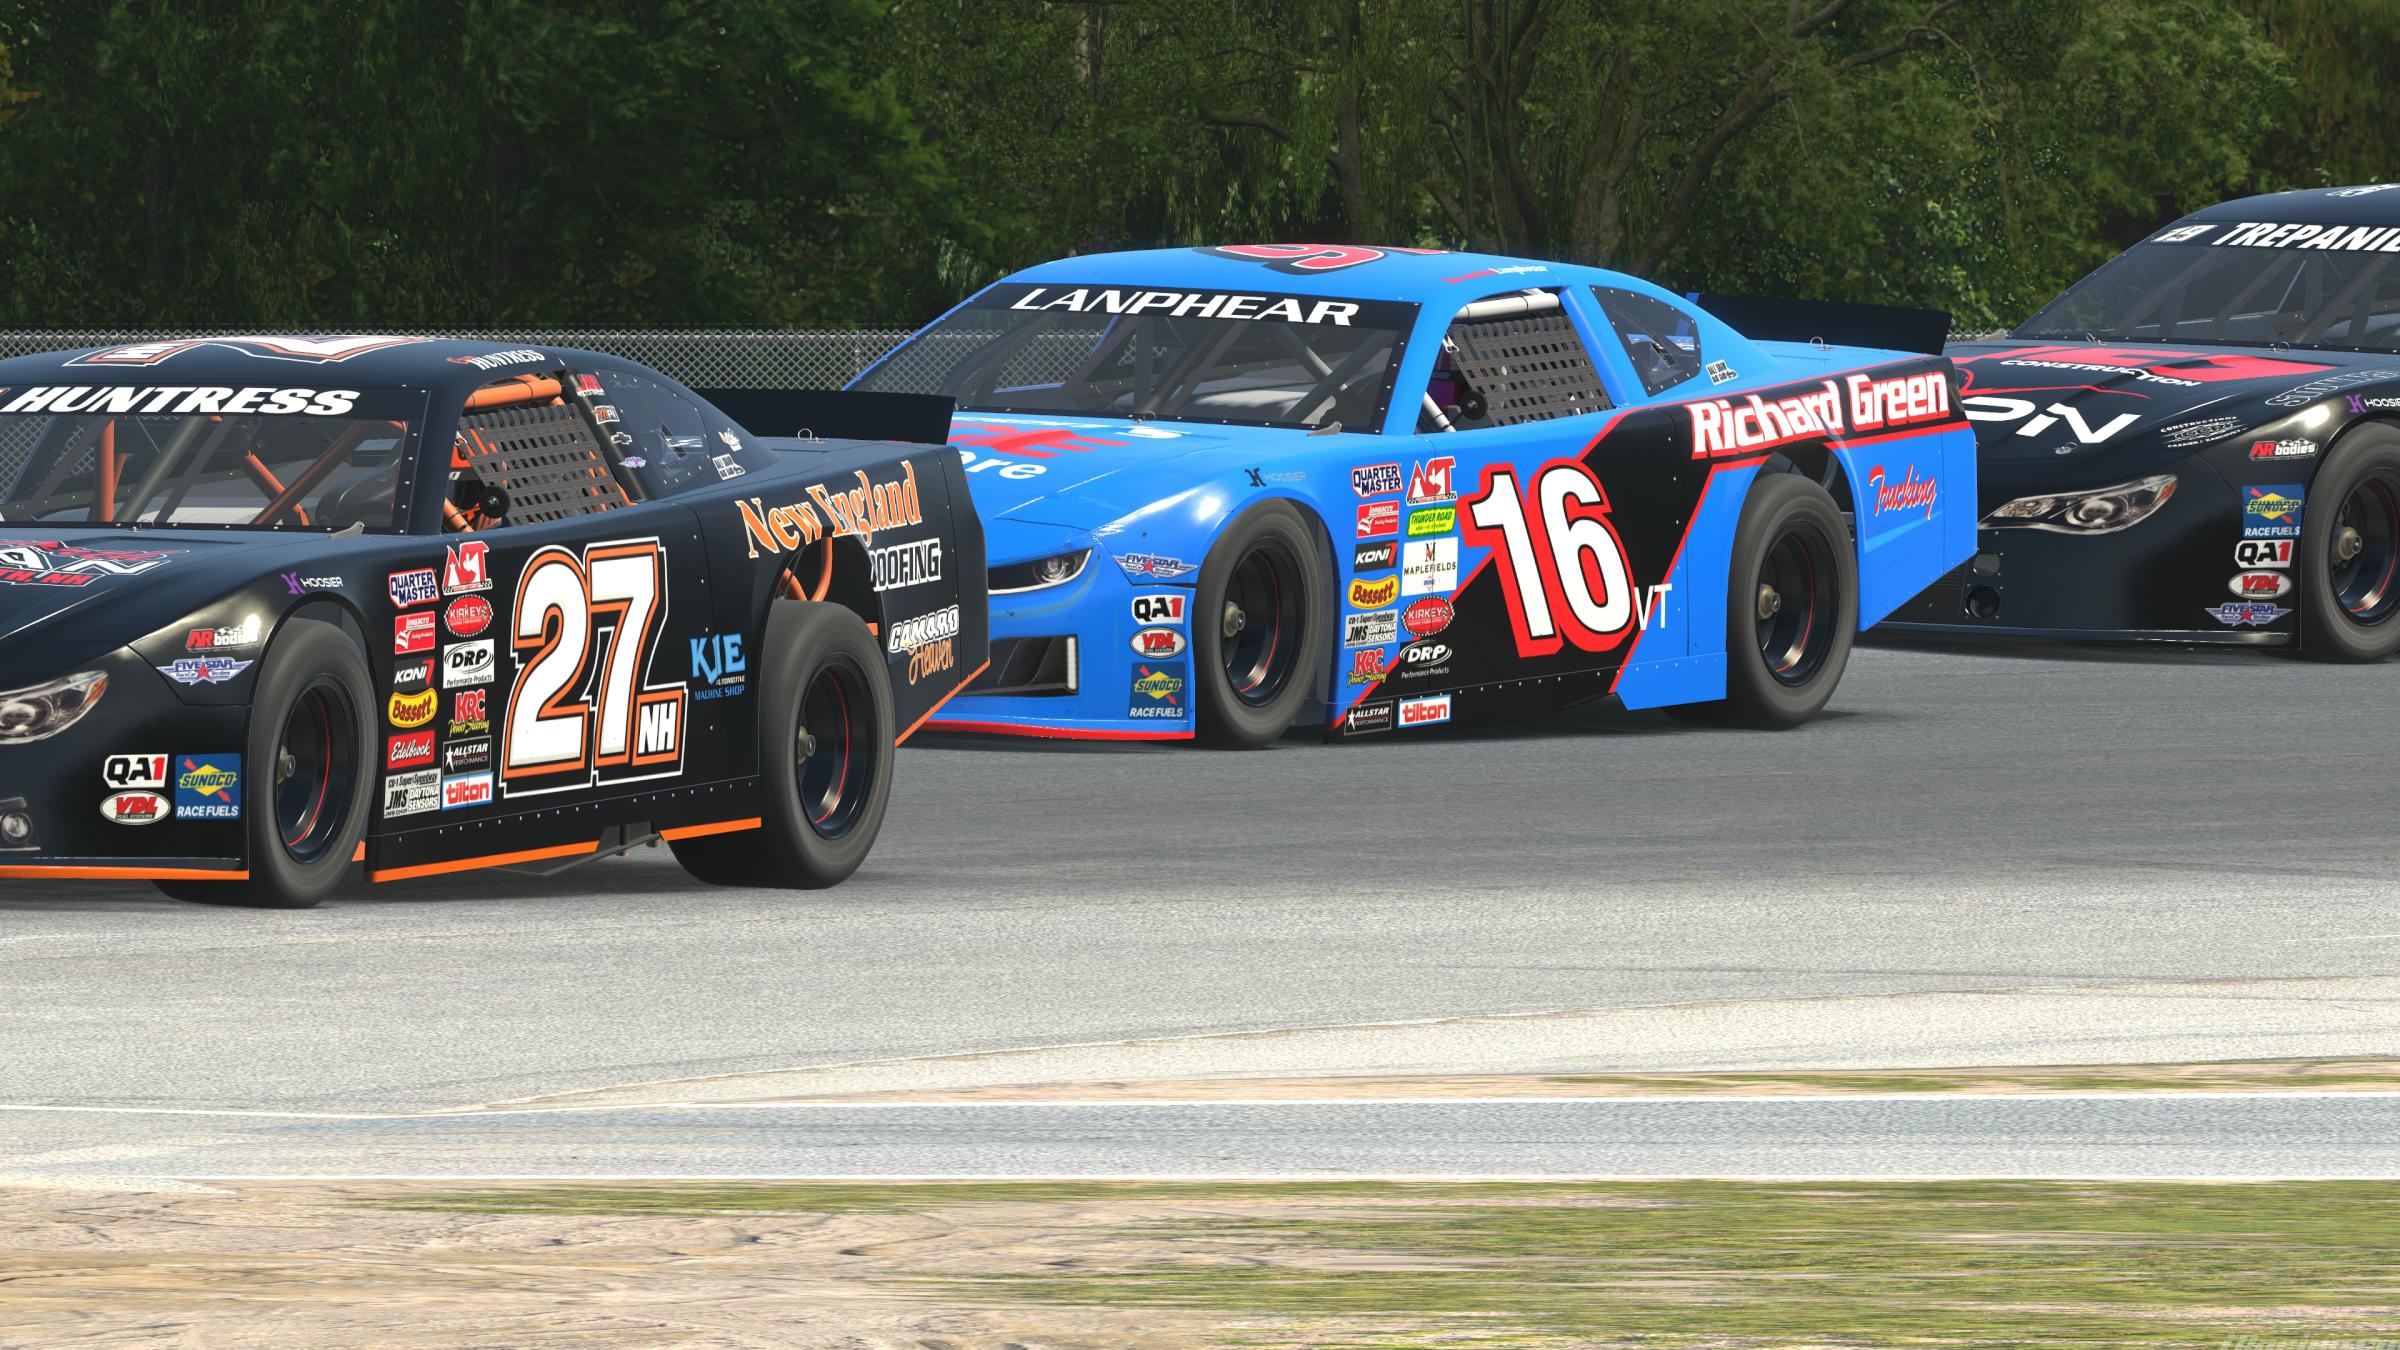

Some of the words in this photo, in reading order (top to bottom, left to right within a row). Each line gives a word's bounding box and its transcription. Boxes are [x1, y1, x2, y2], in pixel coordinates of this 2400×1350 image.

[1010, 288, 1360, 327] LANPHEAR
[468, 349, 546, 371] HUNTRESS
[2000, 359, 2203, 387] CONSTRUCTION
[1, 386, 362, 415] HUNTRESS
[1685, 380, 1845, 460] Richard
[1845, 371, 1950, 431] Green
[2249, 441, 2277, 458] AR
[2275, 443, 2317, 456] bodies
[1353, 465, 1398, 488] QUARTER
[1361, 477, 1401, 496] MASTER
[1869, 464, 1937, 521] Trucking
[735, 497, 822, 559] New
[805, 460, 922, 547] England
[1435, 510, 1453, 522] ROAD
[2247, 499, 2301, 514] SUNOCO
[2244, 527, 2271, 537] RACE
[2271, 526, 2301, 537] FUELS
[1126, 554, 1152, 564] FIVE
[1151, 557, 1180, 569] STAR
[1355, 548, 1391, 565] KONI
[1466, 461, 1638, 650] 16
[1634, 583, 1673, 631] VT
[2237, 540, 2293, 566] QA1
[1404, 561, 1457, 576] MAPLEFIELDS
[300, 577, 344, 589] HOOSIER
[390, 571, 434, 597] QUARTER
[2242, 575, 2281, 590] VDL
[398, 584, 437, 605] MASTER
[1352, 581, 1394, 605] Bassett
[449, 605, 482, 620] KIRKEY
[1134, 597, 1183, 622] QA1
[1408, 607, 1442, 620] KIRKEY
[2221, 605, 2247, 614] FIVE
[2250, 605, 2275, 614] STAR
[888, 604, 959, 653] CAMARO
[1346, 625, 1368, 642] JMS
[1367, 631, 1396, 643] SENSORS
[1368, 622, 1396, 634] DAYTONA
[186, 629, 214, 649] AR
[214, 632, 259, 646] bodi
[1142, 632, 1176, 649] VDL
[451, 648, 488, 669] DRP
[503, 543, 661, 779] 27
[637, 699, 680, 757] NH
[903, 638, 954, 686] Heaven
[1353, 647, 1385, 677] KRC
[1407, 644, 1447, 664] DRP
[174, 660, 201, 672] FIVE
[203, 658, 234, 670] STAR
[394, 664, 428, 685] KONI
[1401, 669, 1429, 680] Performance
[1429, 667, 1450, 676] Products
[446, 677, 473, 687] Performance
[473, 674, 493, 683] Products
[1135, 678, 1182, 692] SUNOCO
[694, 688, 724, 701] MACHINE
[724, 685, 745, 697] SHOP
[392, 695, 433, 723] Bassett
[455, 689, 486, 725] KRC
[1129, 707, 1155, 718] RACE
[1155, 707, 1184, 718] FUELS
[1354, 706, 1390, 719] ALLSTAR
[1402, 703, 1448, 723] tilton
[1354, 716, 1390, 726] PERFORMANCE
[391, 738, 431, 762] Edelbrock
[452, 743, 489, 757] ALLSTAR
[452, 755, 489, 767] PERFORMANCE
[106, 757, 166, 786] QA1
[180, 773, 236, 788] SUNOCO
[385, 789, 409, 811] JMS
[409, 784, 439, 800] DAYTONA
[445, 780, 490, 805] tilton
[115, 796, 159, 815] VDL
[176, 806, 206, 818] RACE
[205, 805, 240, 817] FUELS
[408, 797, 439, 813] SENSORS
